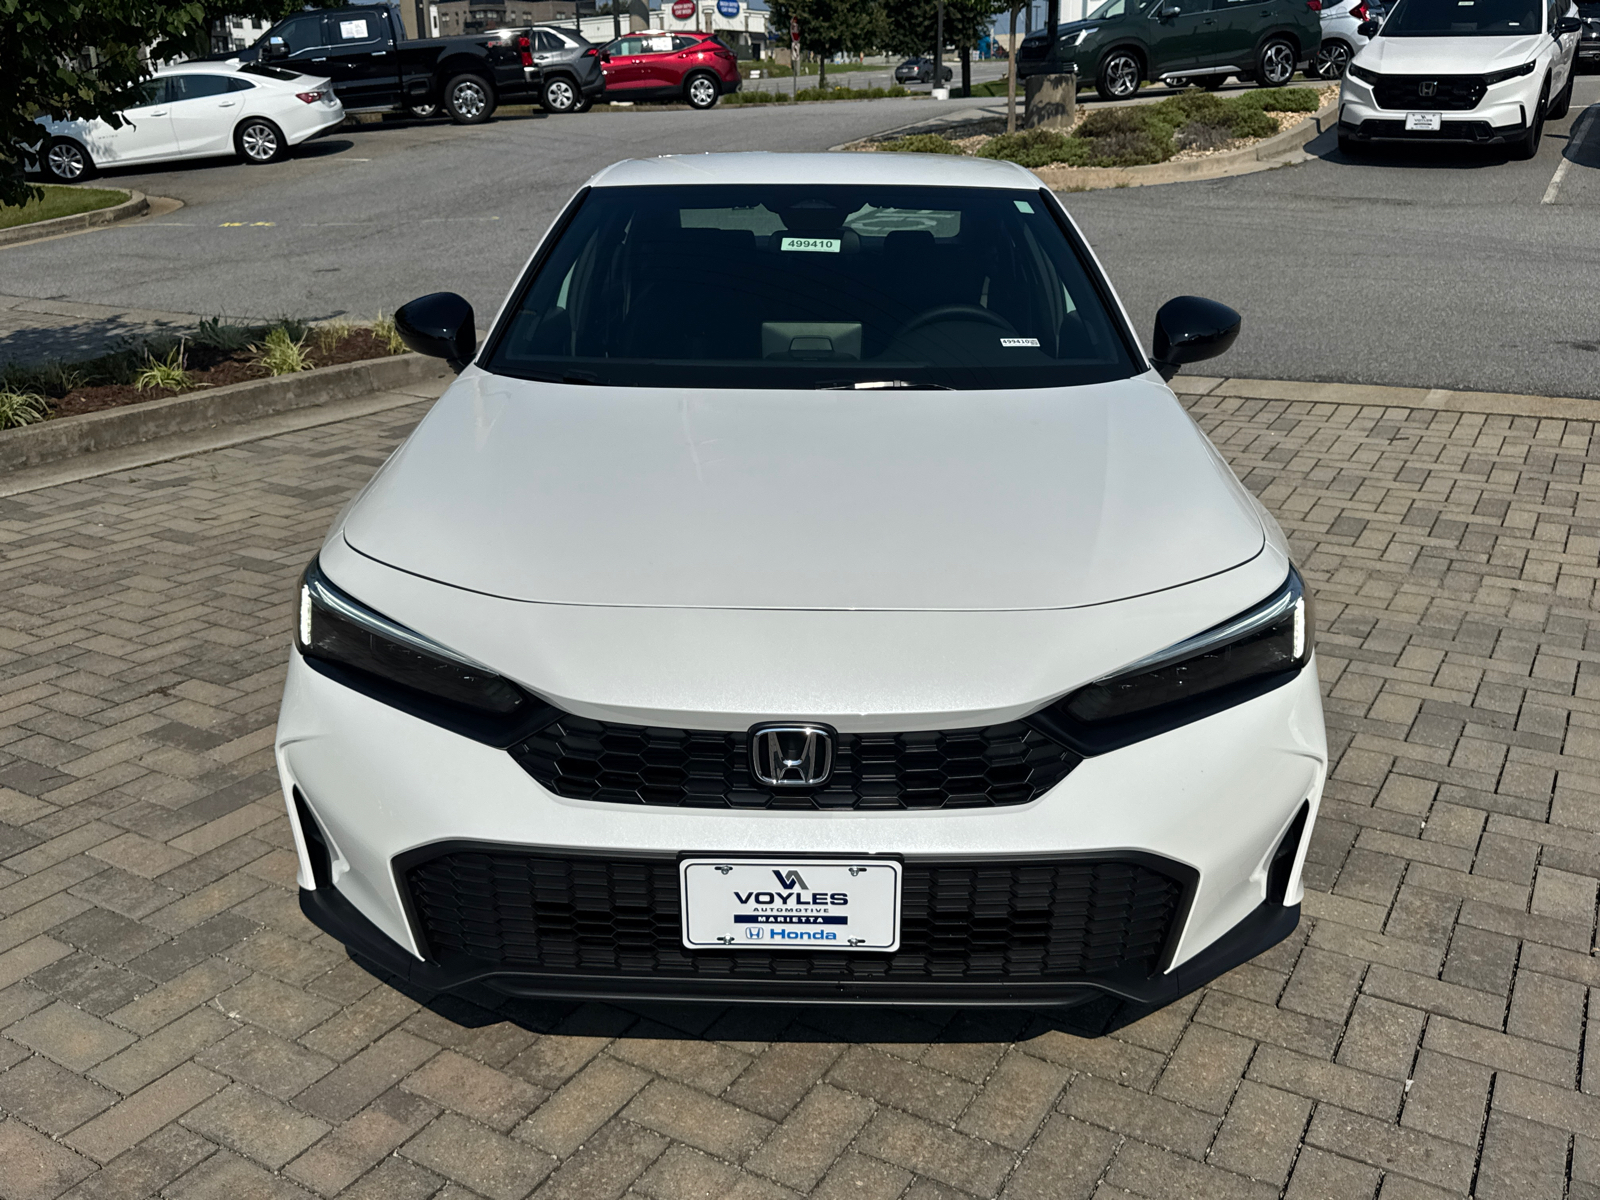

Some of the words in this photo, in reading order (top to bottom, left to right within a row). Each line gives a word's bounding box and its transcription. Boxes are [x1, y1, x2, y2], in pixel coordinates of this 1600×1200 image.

[788, 240, 833, 248] 499410
[733, 892, 849, 905] VOYLES
[770, 928, 837, 940] Honda
